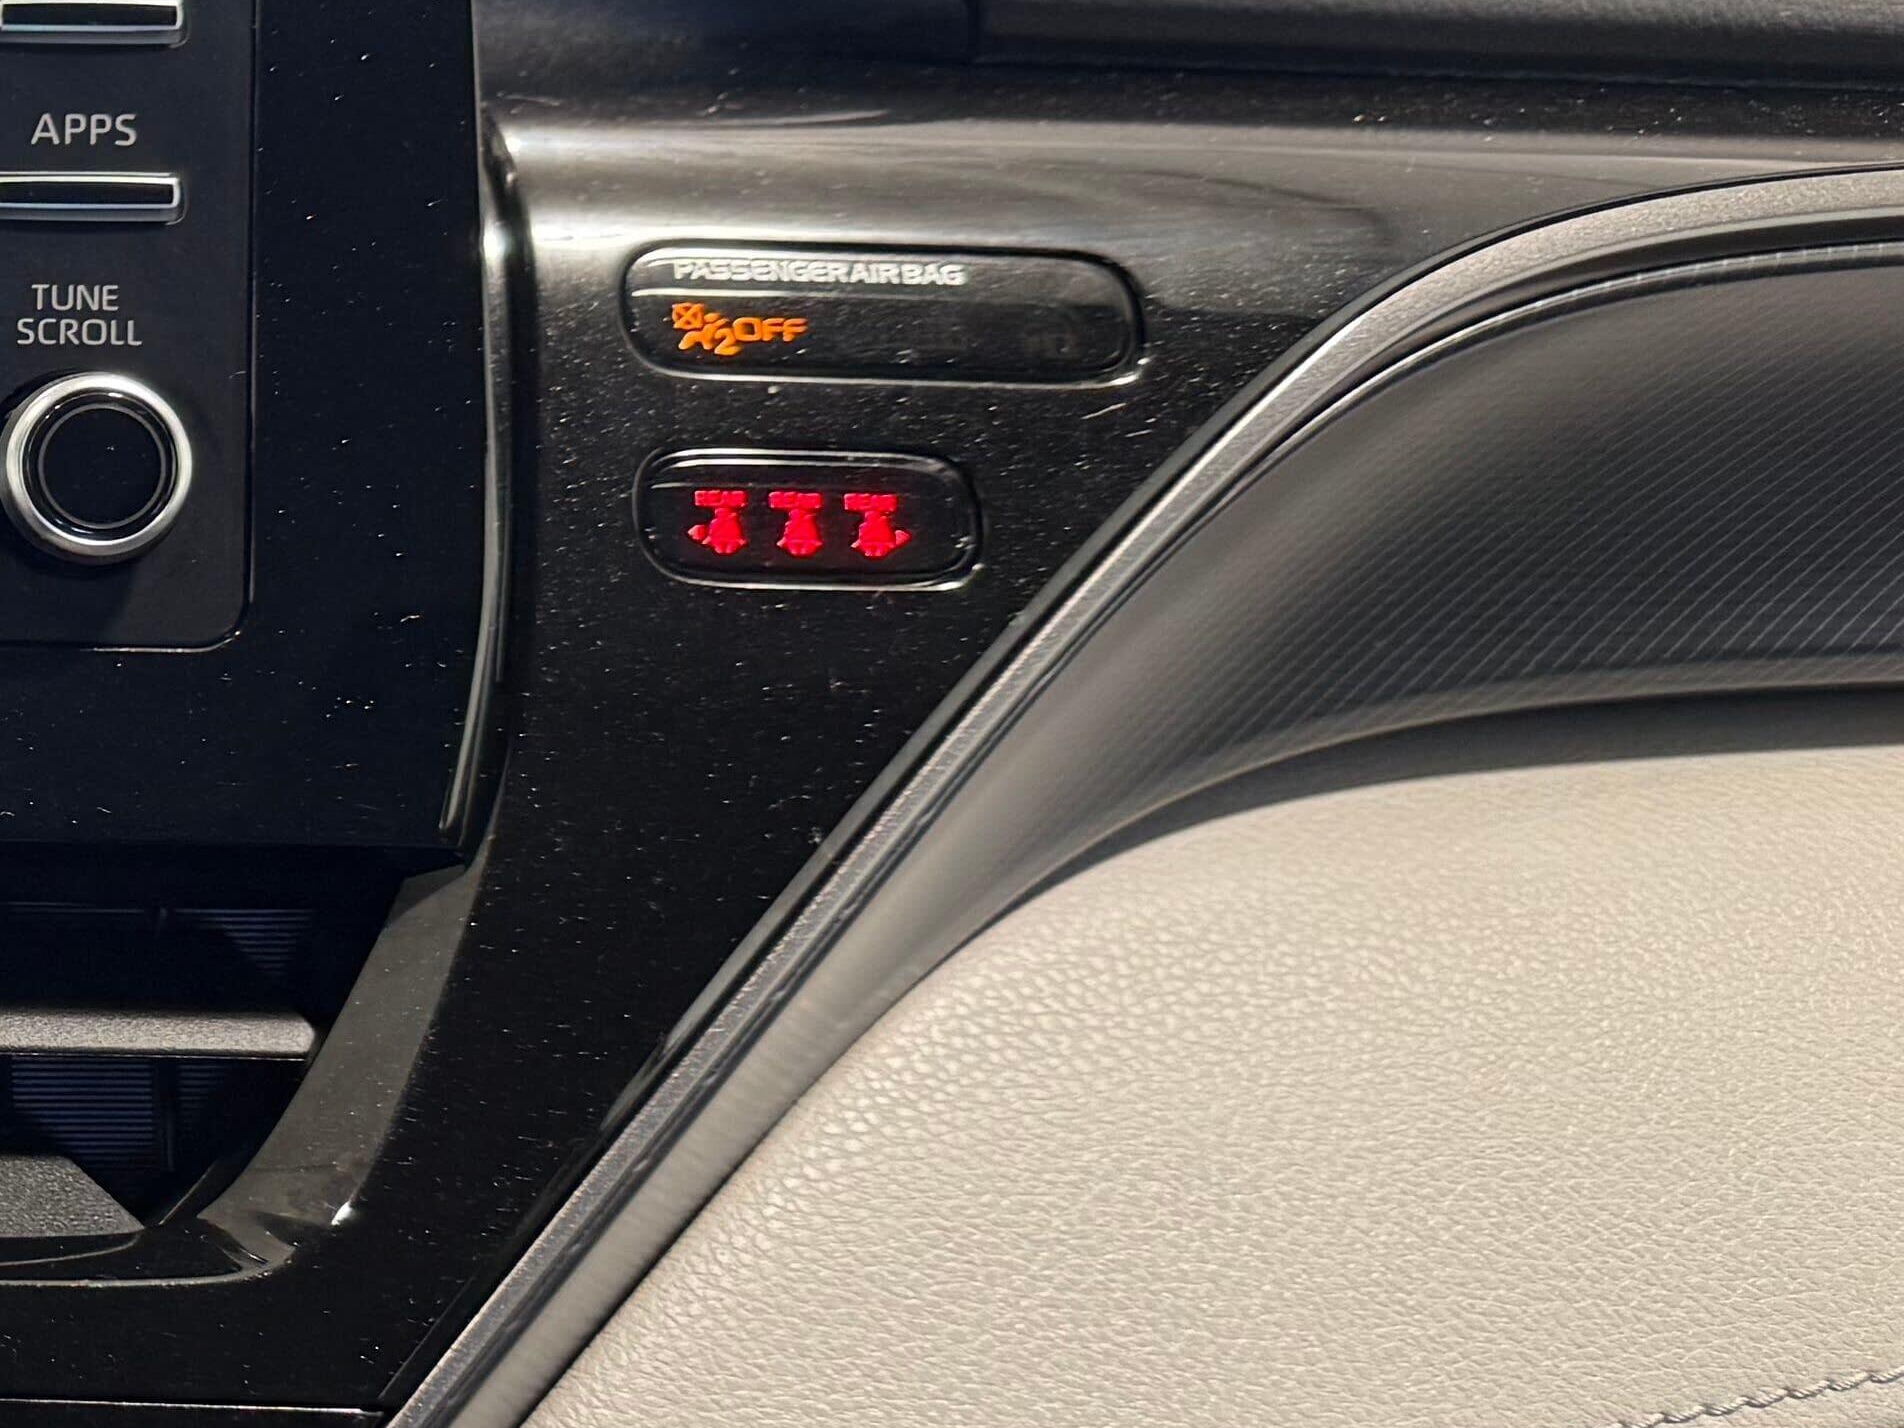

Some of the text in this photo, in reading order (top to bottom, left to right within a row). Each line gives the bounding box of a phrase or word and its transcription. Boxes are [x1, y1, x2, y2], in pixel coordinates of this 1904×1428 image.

[31, 113, 138, 146] APPS
[31, 283, 120, 312] TUNE
[16, 317, 143, 347] SCROLL
[732, 316, 808, 342] OFF
